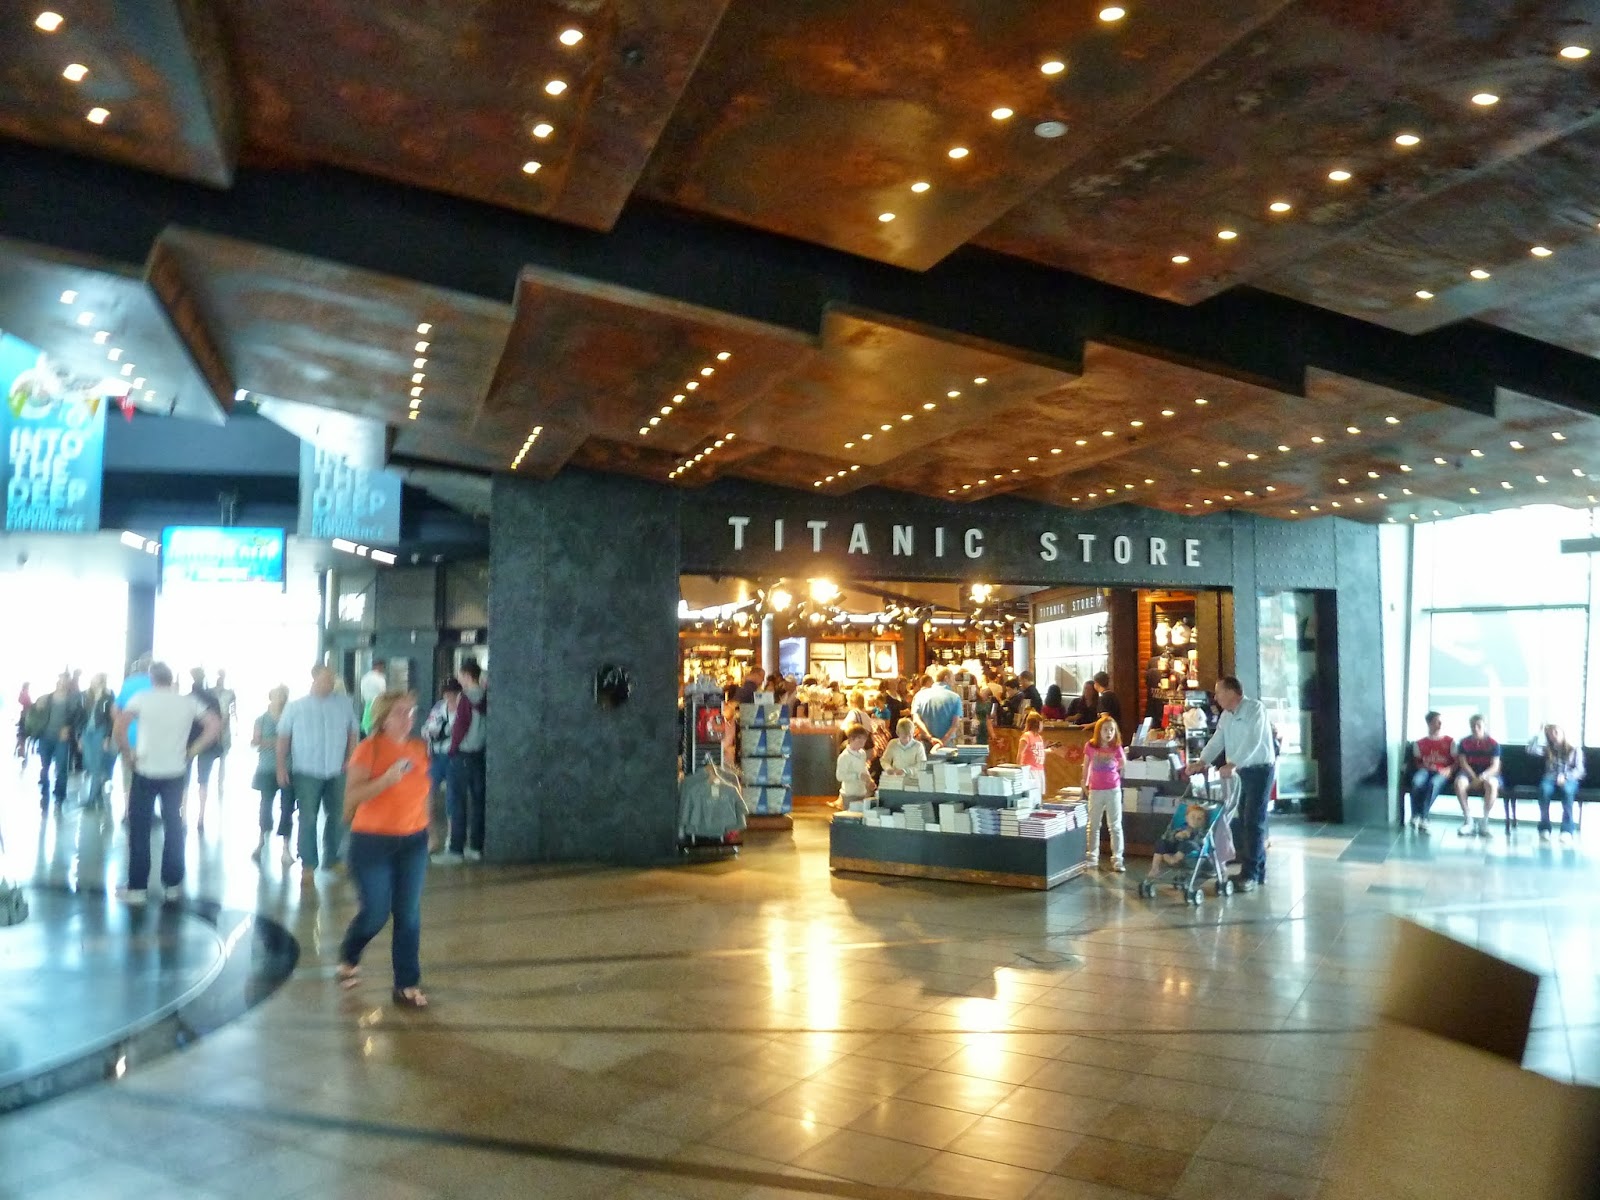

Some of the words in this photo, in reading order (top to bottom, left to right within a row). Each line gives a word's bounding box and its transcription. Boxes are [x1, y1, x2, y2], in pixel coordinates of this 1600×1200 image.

[9, 426, 84, 464] INTO
[13, 456, 69, 486] THE
[7, 478, 87, 510] DEEP
[728, 516, 984, 559] TITANIC
[1040, 532, 1201, 567] STORE
[1040, 603, 1065, 617] TITANIC
[1072, 597, 1095, 611] STORE
